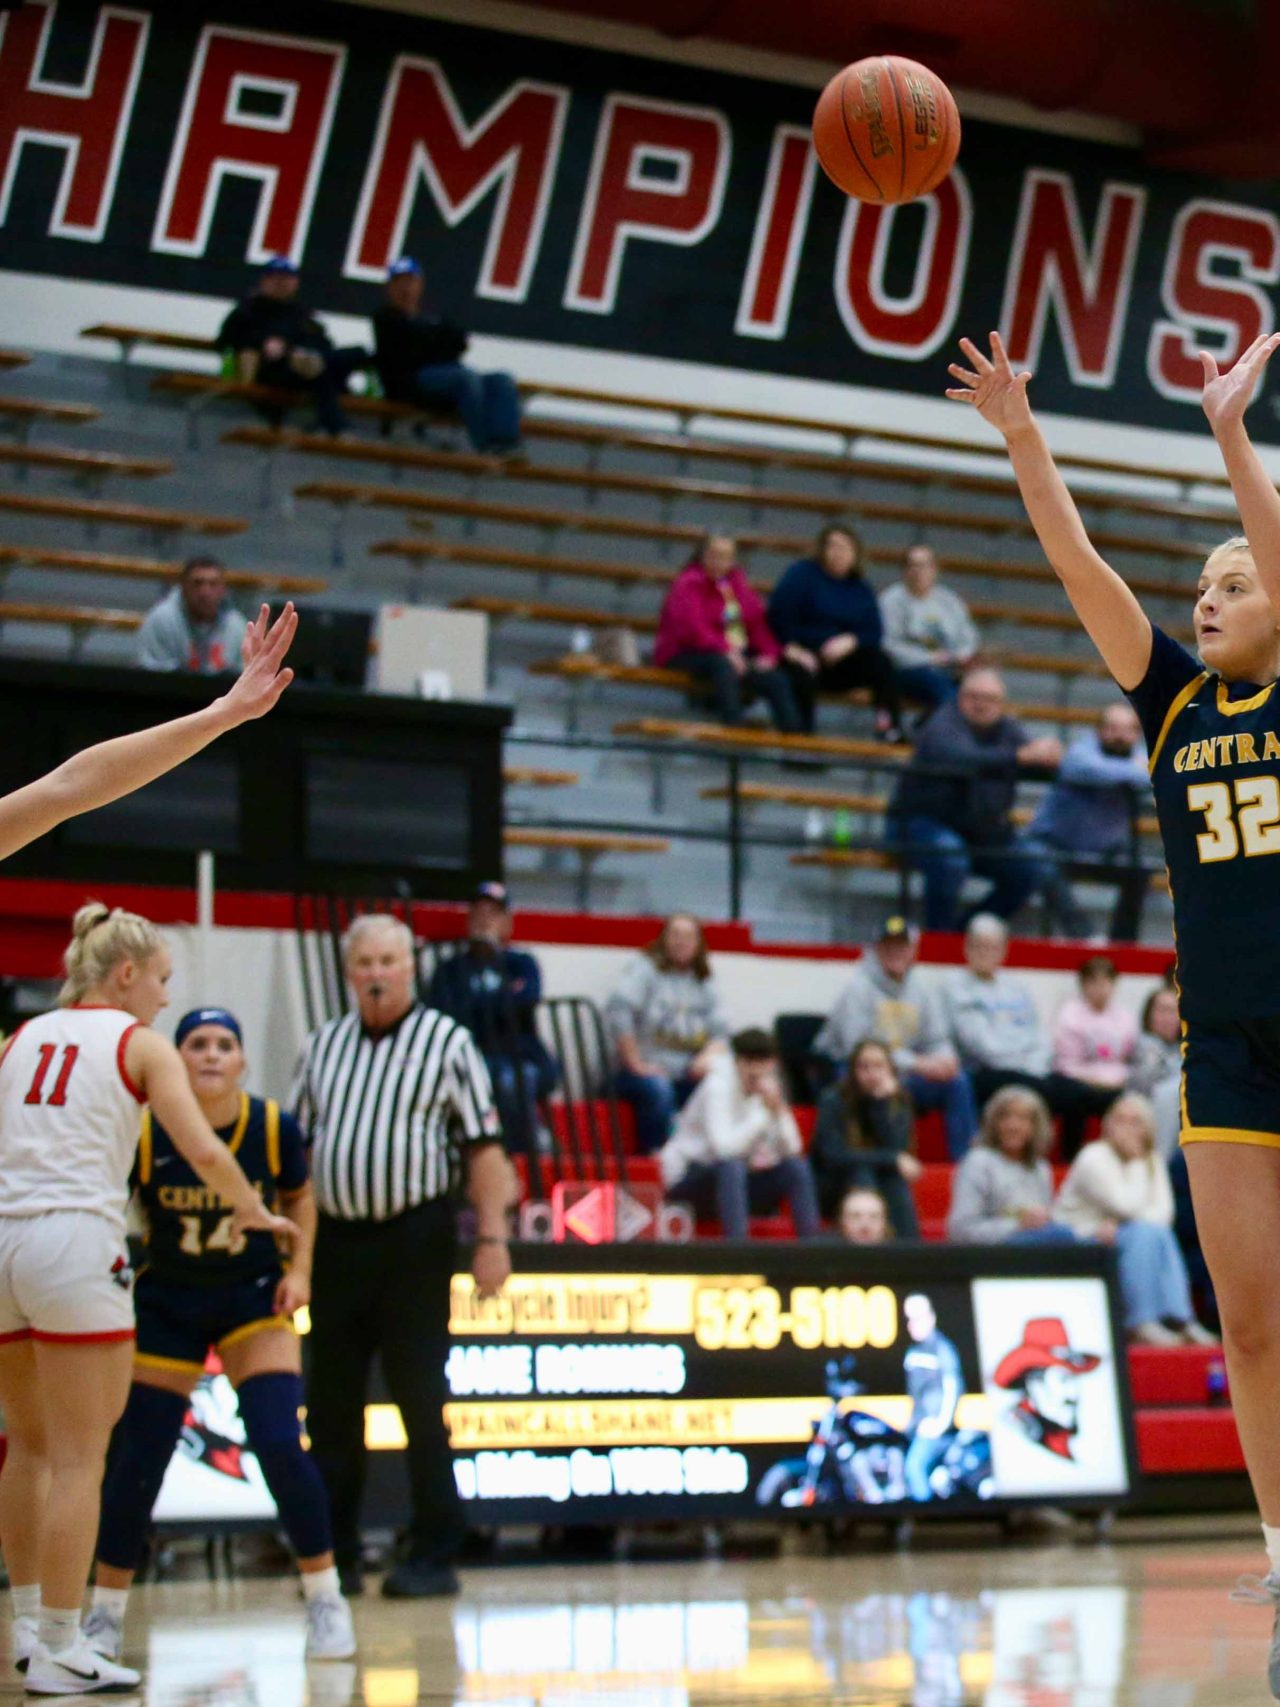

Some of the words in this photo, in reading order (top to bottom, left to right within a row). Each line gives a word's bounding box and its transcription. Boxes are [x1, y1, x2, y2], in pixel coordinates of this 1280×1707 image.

[24, 1043, 79, 1106] 11
[157, 1181, 264, 1211] CENT
[179, 1214, 248, 1257] 14
[695, 1285, 899, 1350] 523-5100
